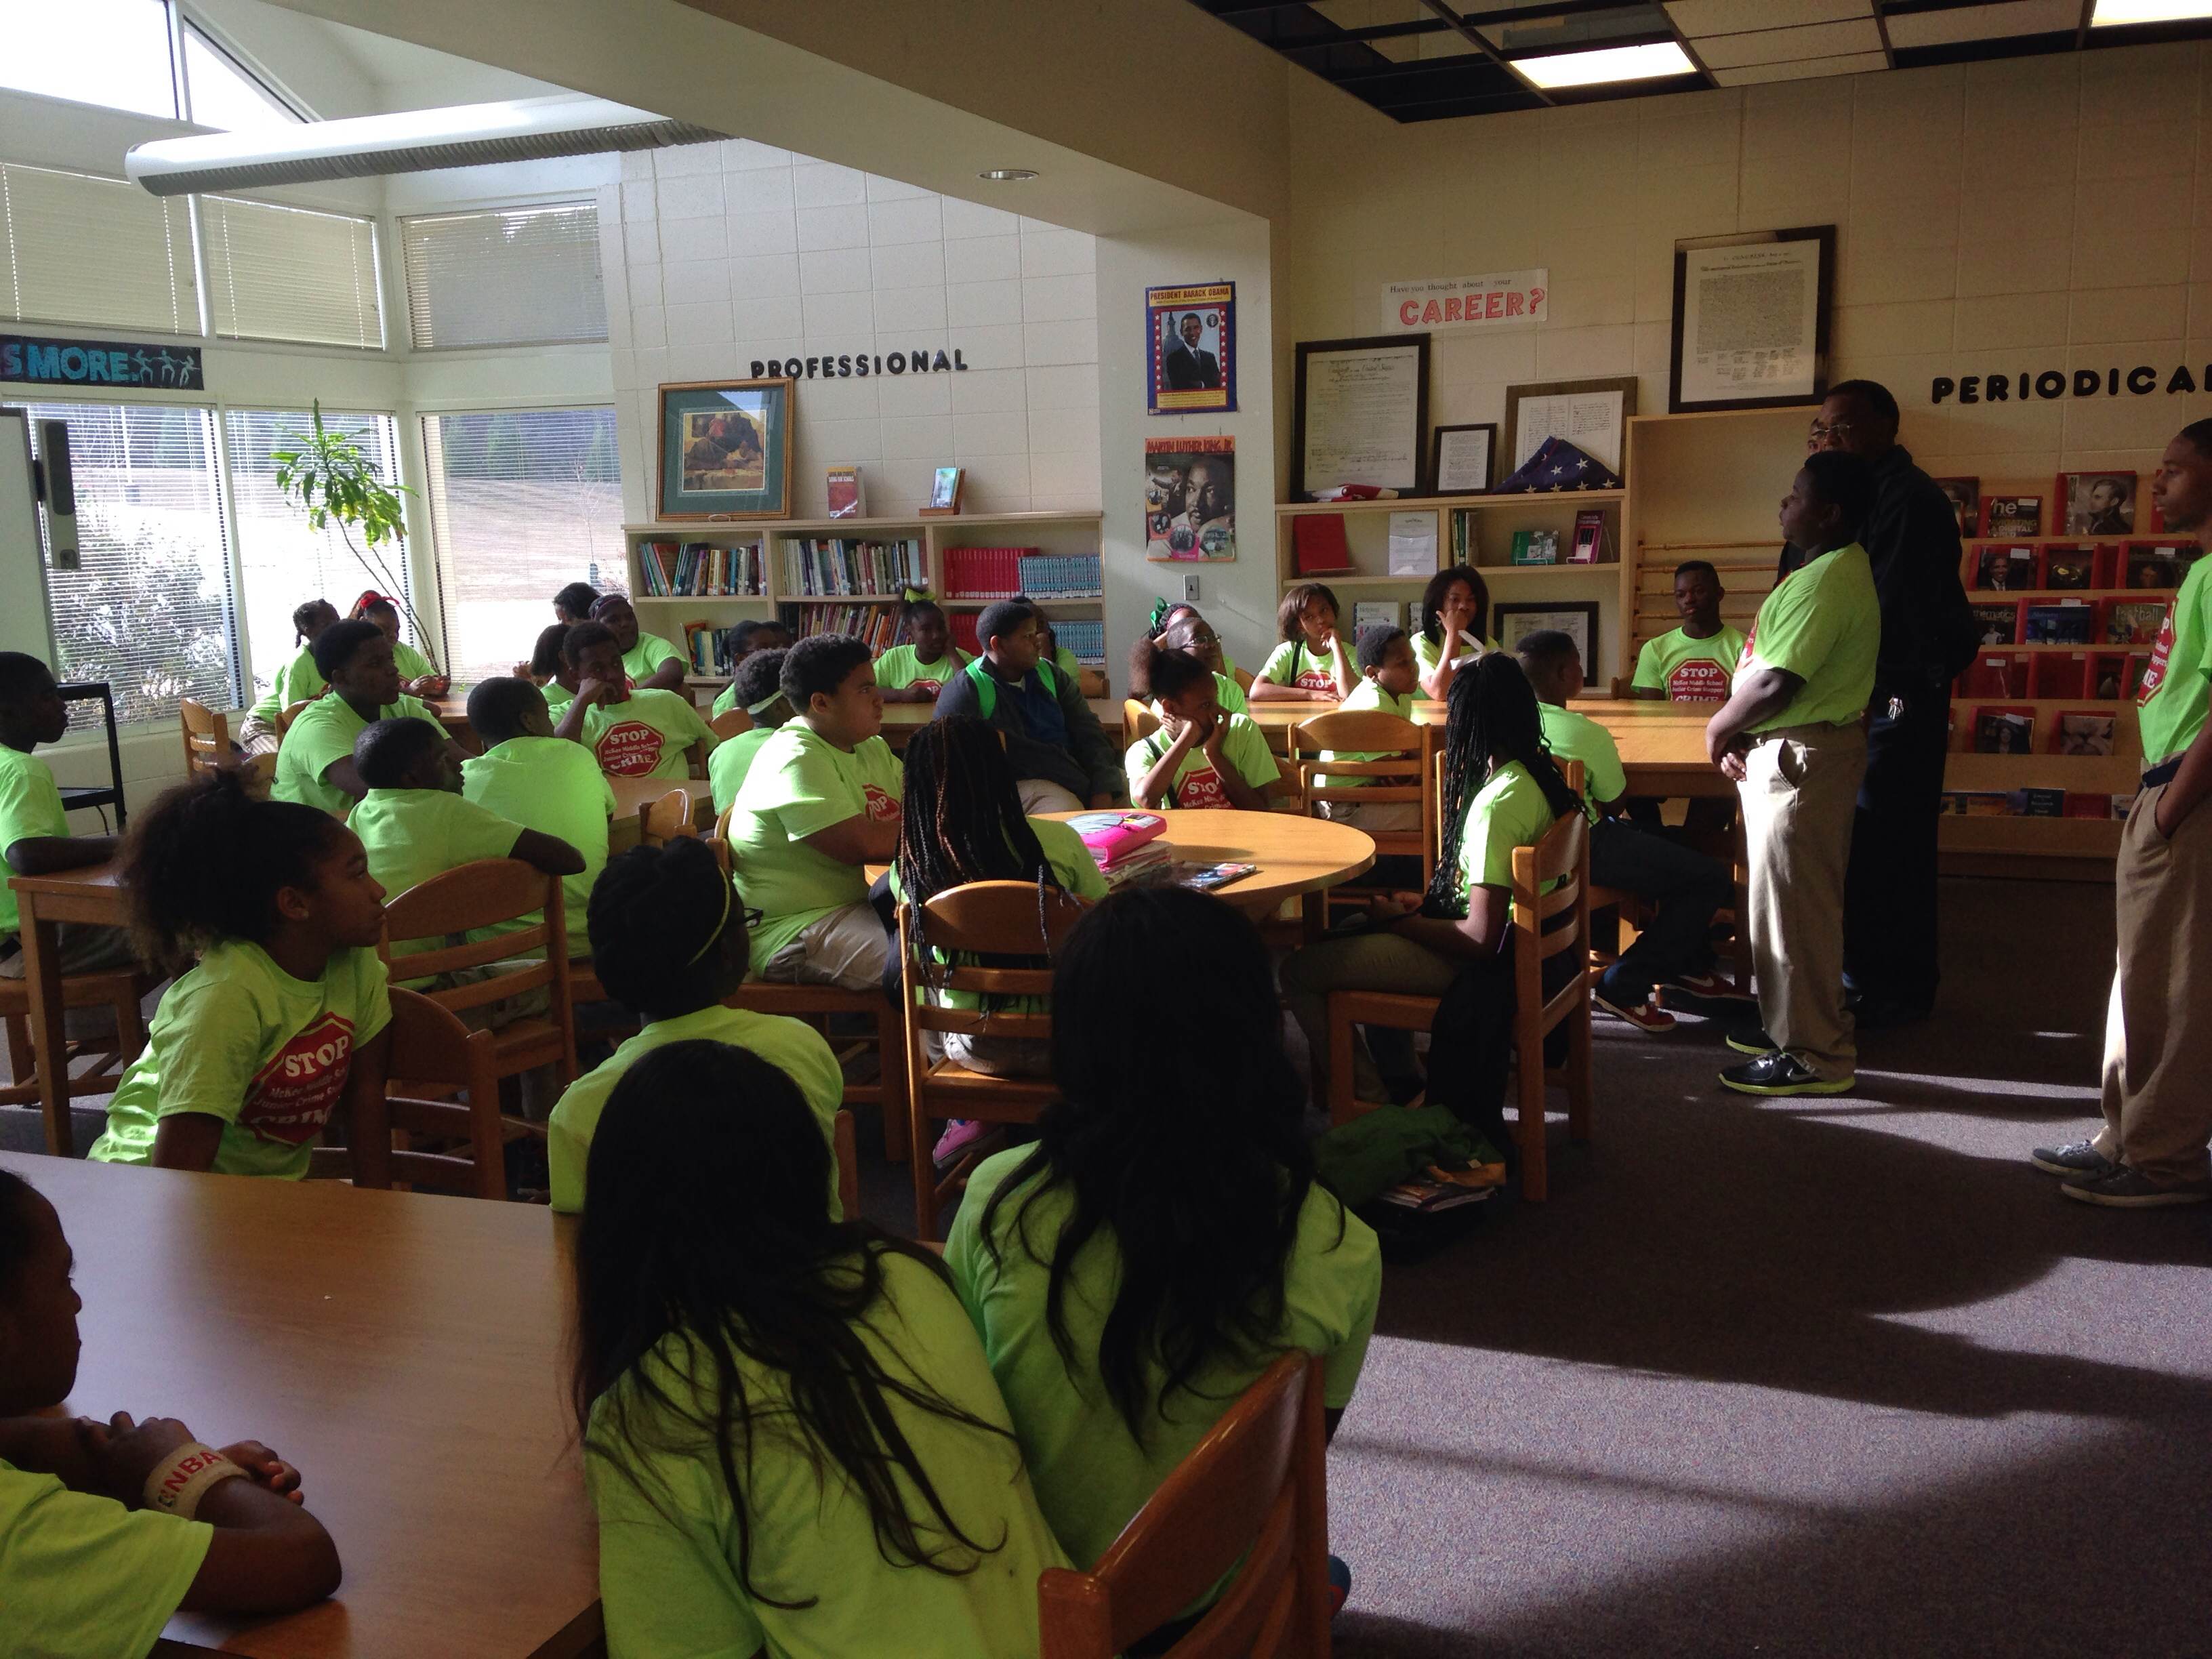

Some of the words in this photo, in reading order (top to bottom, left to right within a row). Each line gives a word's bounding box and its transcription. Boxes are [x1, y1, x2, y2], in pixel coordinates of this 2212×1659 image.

[1150, 291, 1181, 300] PRESIDENT
[1183, 289, 1206, 298] BARACK
[1208, 287, 1229, 296] OBAMA
[1390, 285, 1409, 293] Have
[1411, 285, 1424, 294] you
[1428, 282, 1457, 293] thought
[1462, 281, 1483, 289] about
[1494, 278, 1512, 287] your
[1399, 287, 1545, 326] CAREER?
[26, 343, 138, 382] MORE.
[750, 348, 968, 380] PROFESSIONAL
[1147, 441, 1174, 453] MARTIN
[1176, 440, 1202, 452] LUTHER
[1681, 668, 1718, 677] STOP
[1300, 678, 1333, 688] STOP
[610, 729, 649, 745] STOP
[285, 1036, 349, 1078] STOP
[164, 1450, 223, 1493] NBA
